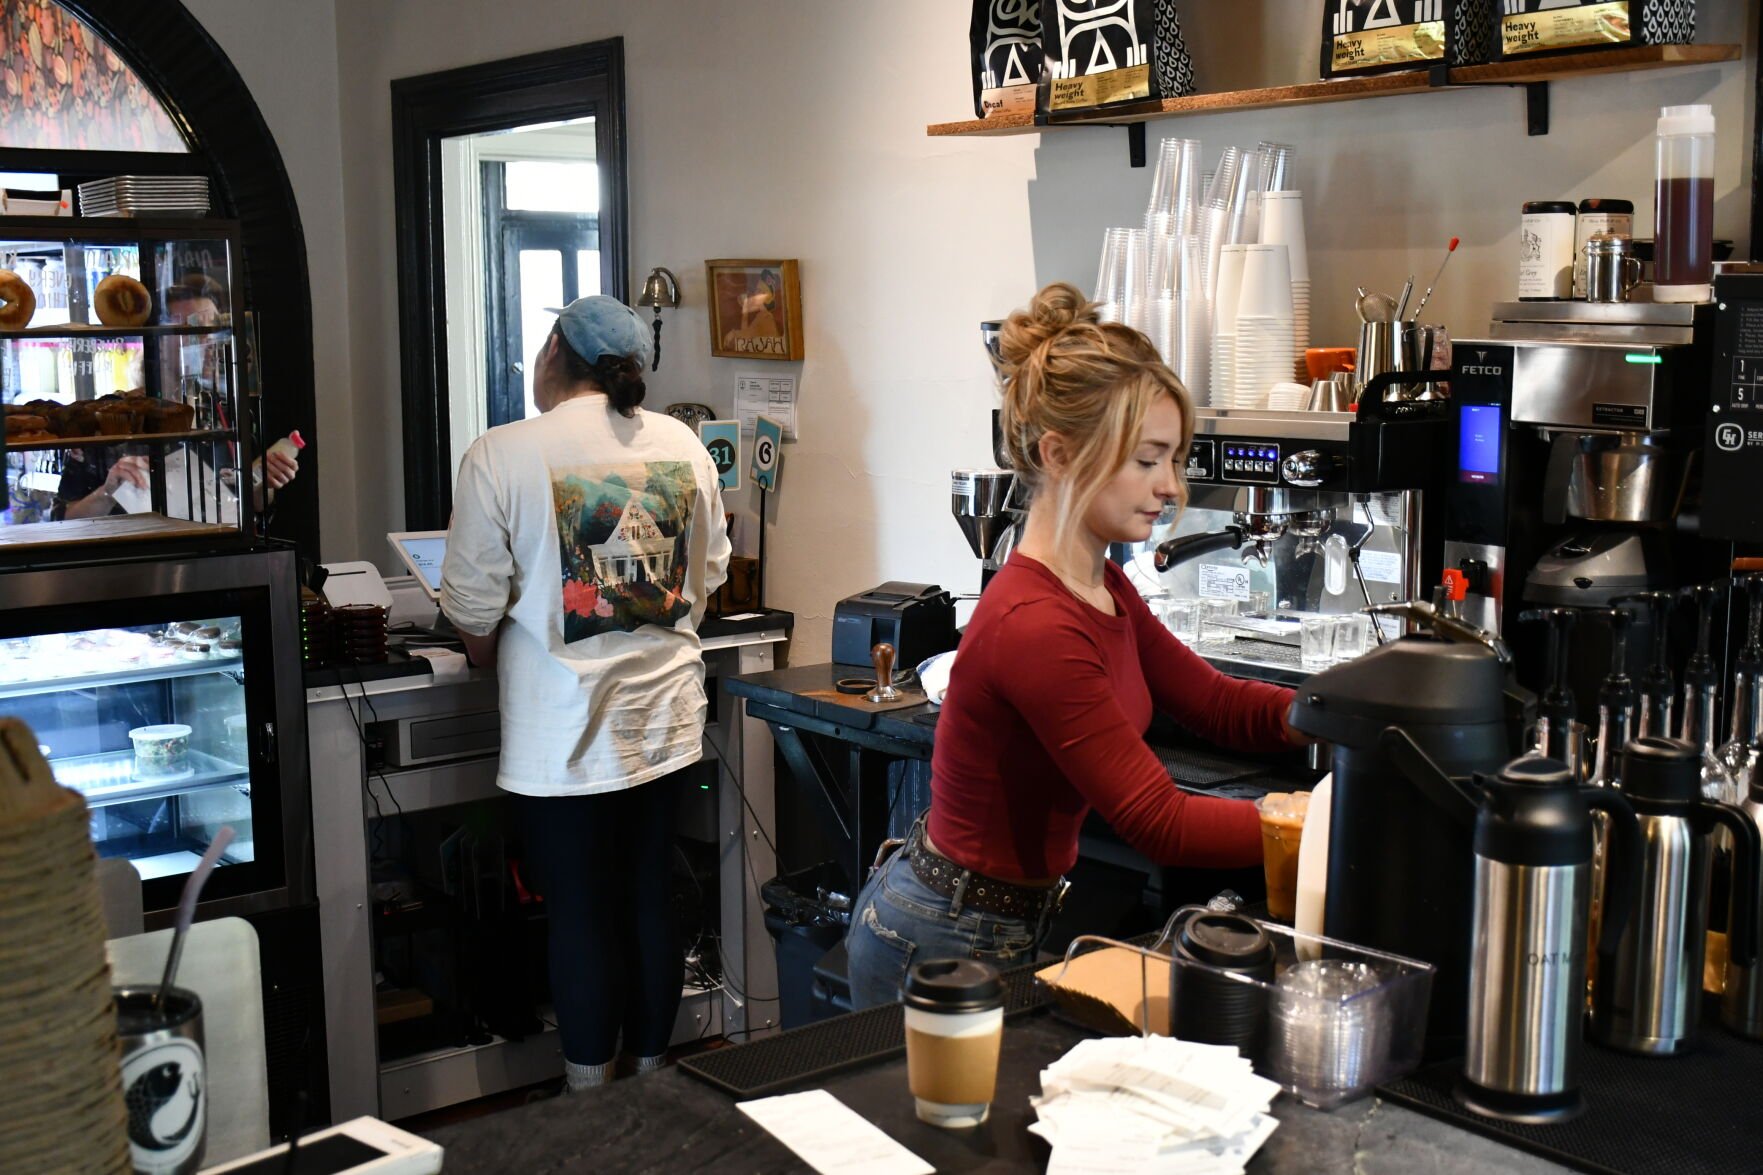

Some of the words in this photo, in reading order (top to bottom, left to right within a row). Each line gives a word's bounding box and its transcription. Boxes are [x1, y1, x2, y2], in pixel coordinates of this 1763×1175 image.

[1505, 21, 1536, 32] Heavy
[1506, 31, 1539, 44] weight
[1336, 39, 1362, 50] Heavy
[1335, 48, 1365, 60] weight
[1055, 81, 1083, 91] Heavy
[1054, 89, 1084, 99] weight
[736, 336, 785, 353] RAJAH
[1462, 366, 1502, 376] FETCO
[1738, 387, 1744, 401] 5
[709, 446, 732, 465] 31
[758, 441, 772, 465] 6
[1528, 951, 1558, 966] OAT
